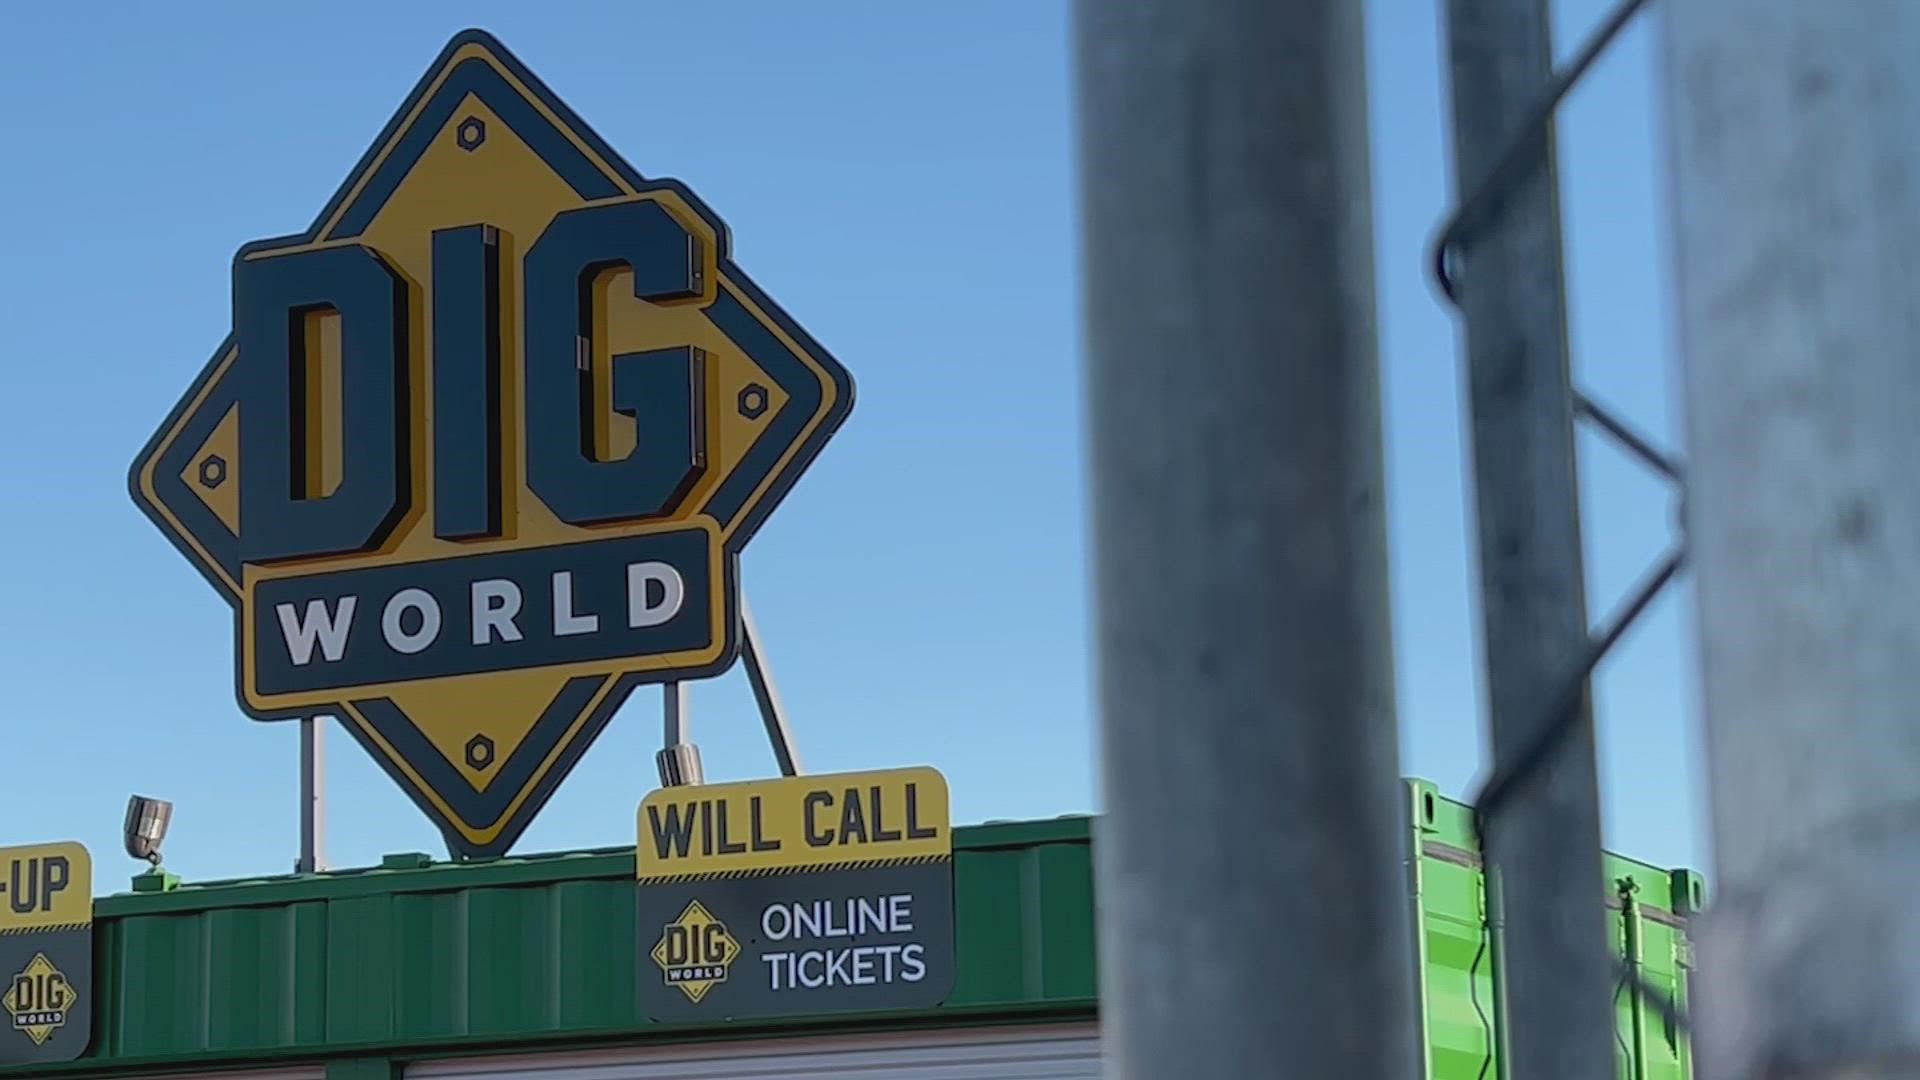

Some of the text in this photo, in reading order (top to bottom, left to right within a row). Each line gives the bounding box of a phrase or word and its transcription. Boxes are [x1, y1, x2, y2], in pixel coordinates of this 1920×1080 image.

[234, 198, 707, 564] DIG
[276, 561, 684, 666] WORLD
[646, 783, 937, 860] WILL CALL
[761, 895, 913, 941] ONLINE
[664, 923, 726, 966] DIG
[761, 944, 926, 990] TICKETS
[16, 973, 64, 1011] DIG
[669, 966, 724, 981] WORLD
[17, 1012, 62, 1025] WORLD
